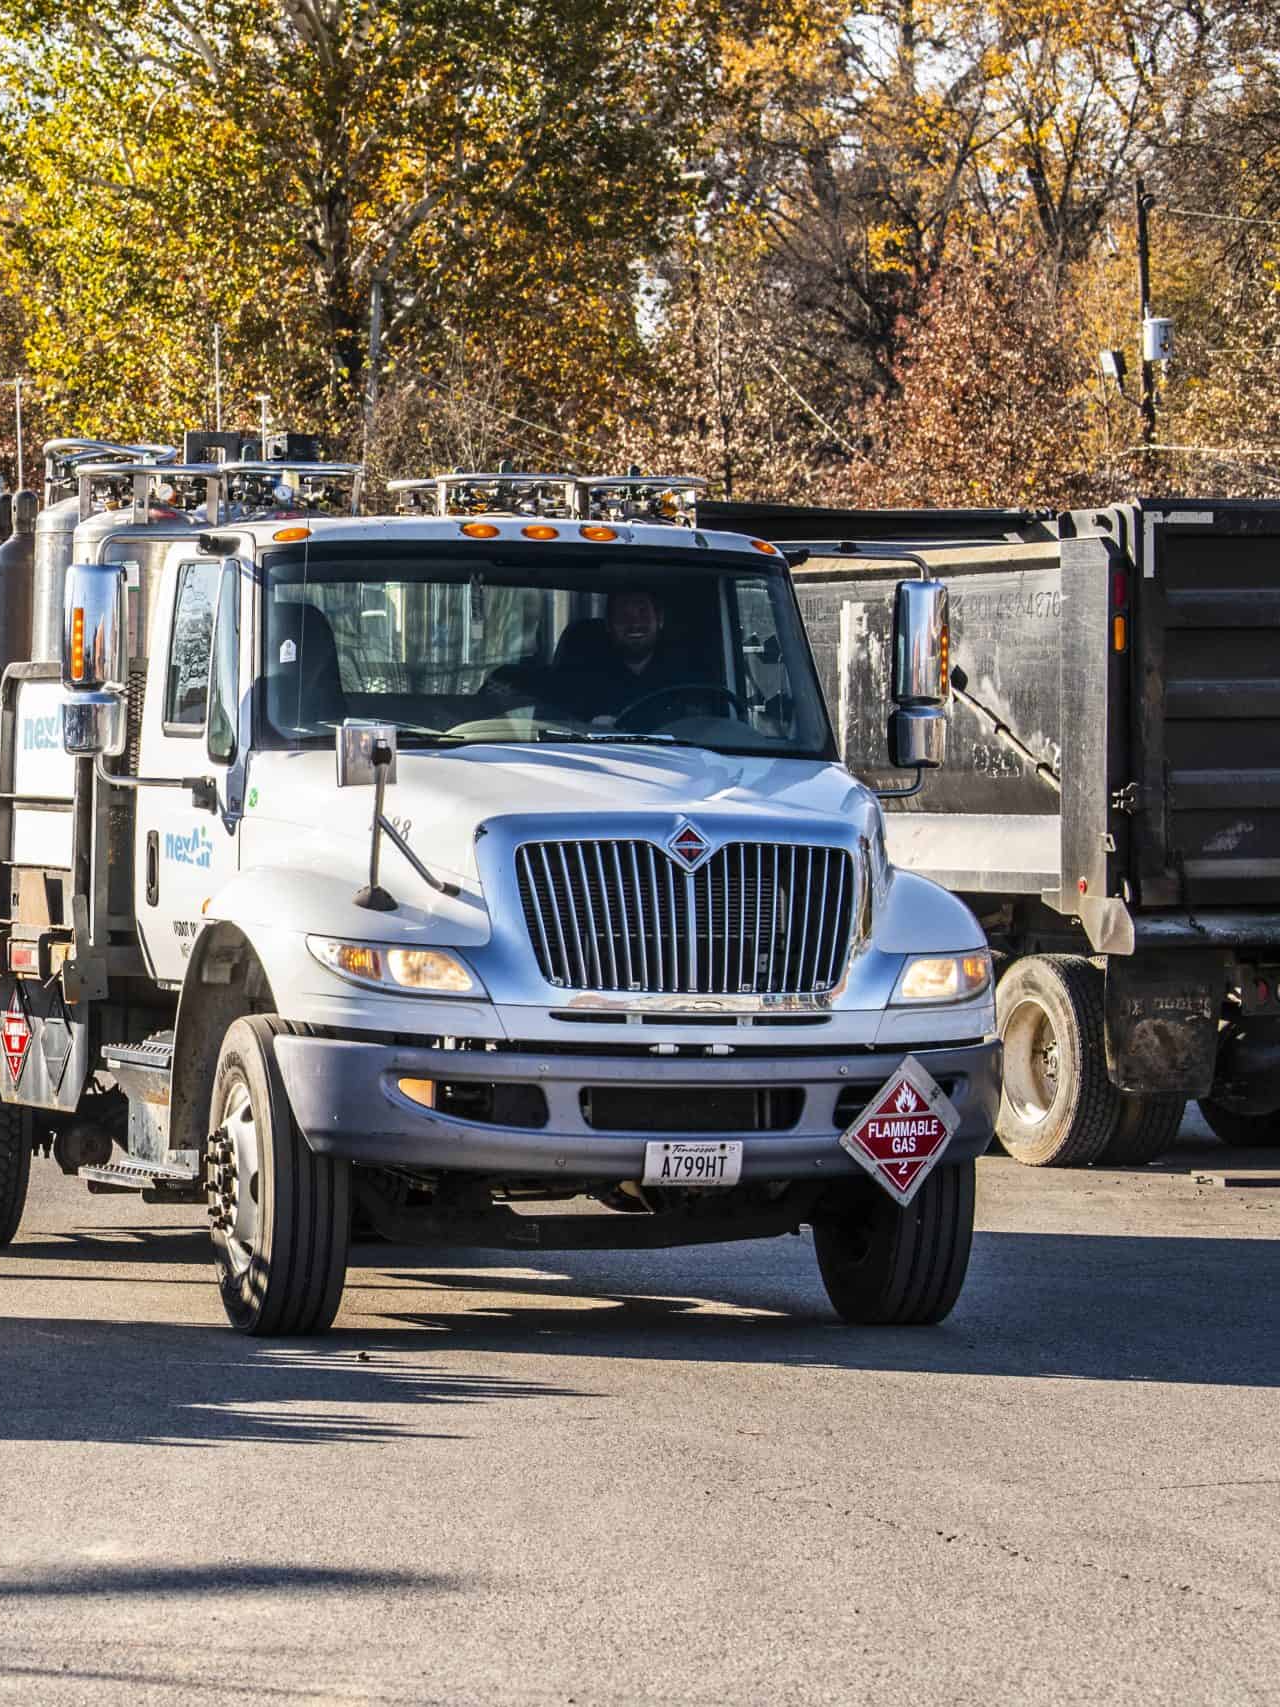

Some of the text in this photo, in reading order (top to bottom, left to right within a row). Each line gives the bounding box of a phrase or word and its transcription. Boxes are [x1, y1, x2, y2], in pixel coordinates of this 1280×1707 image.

[166, 825, 213, 869] nexAir
[867, 1119, 939, 1139] FLAMMABLE
[891, 1137, 916, 1154] GAS
[660, 1155, 728, 1178] A799HT
[898, 1161, 908, 1175] 2
